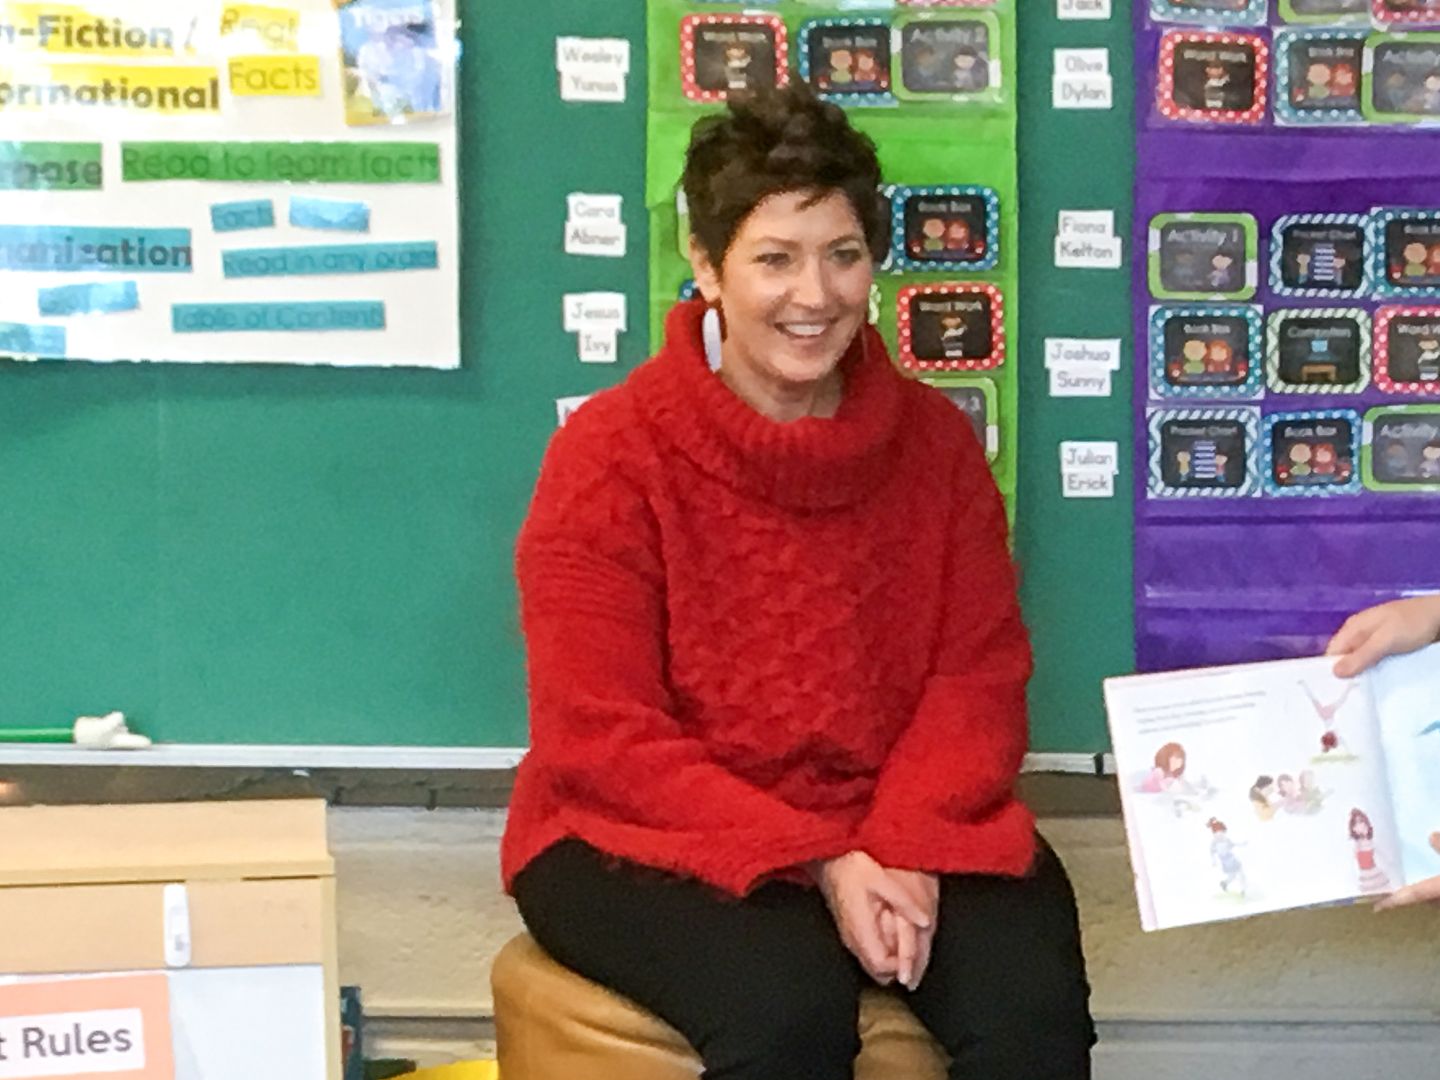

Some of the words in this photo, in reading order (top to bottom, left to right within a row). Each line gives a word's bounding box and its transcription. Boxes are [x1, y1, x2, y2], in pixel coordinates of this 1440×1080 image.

[228, 62, 317, 91] Facts
[1061, 81, 1108, 102] Dylan
[214, 204, 269, 226] act
[1051, 342, 1112, 362] Joshua
[1057, 370, 1106, 391] Sunny
[1067, 473, 1109, 491] Erick
[22, 1022, 133, 1059] Rules
